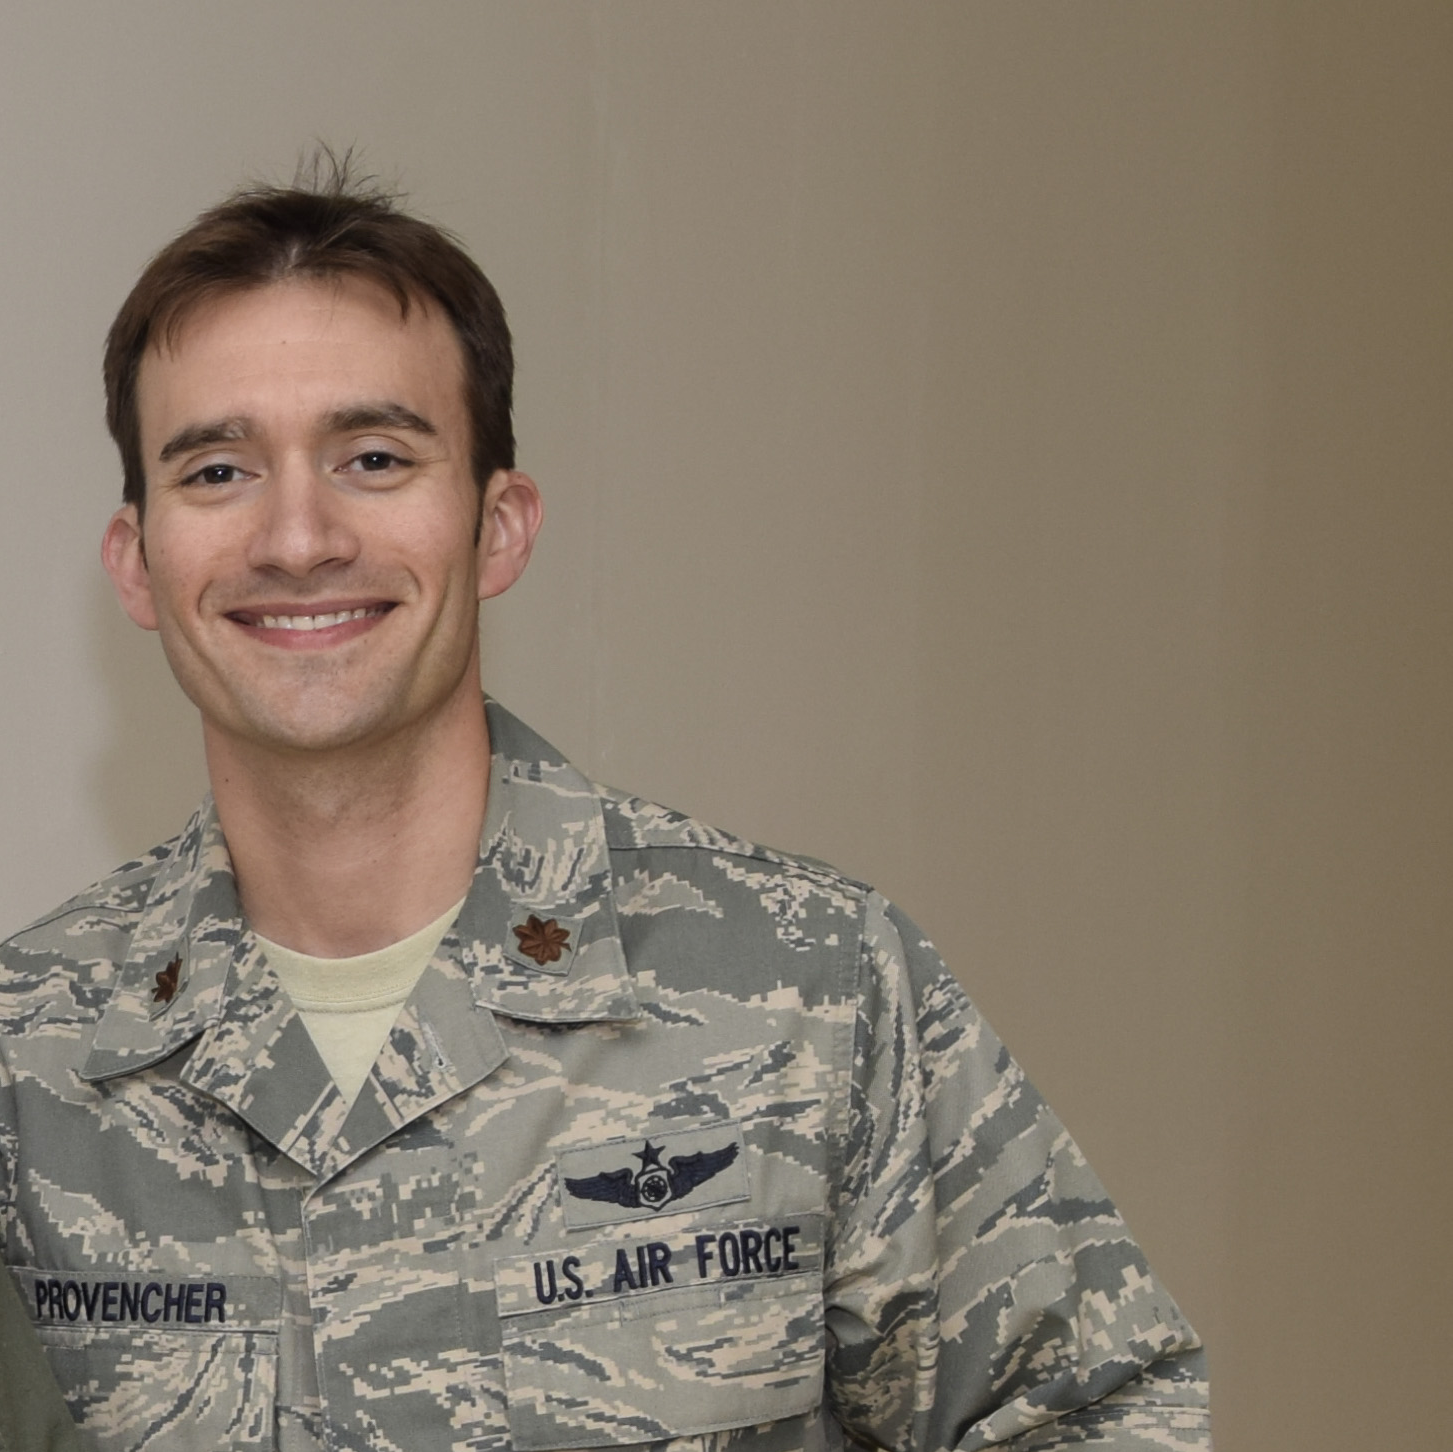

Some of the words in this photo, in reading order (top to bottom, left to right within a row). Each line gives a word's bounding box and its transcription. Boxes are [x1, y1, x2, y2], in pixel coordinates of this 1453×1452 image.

[534, 1258, 593, 1305] U.S.
[614, 1243, 672, 1290] AIR
[695, 1226, 798, 1278] FORCE
[35, 1278, 227, 1324] PROVENCHER
